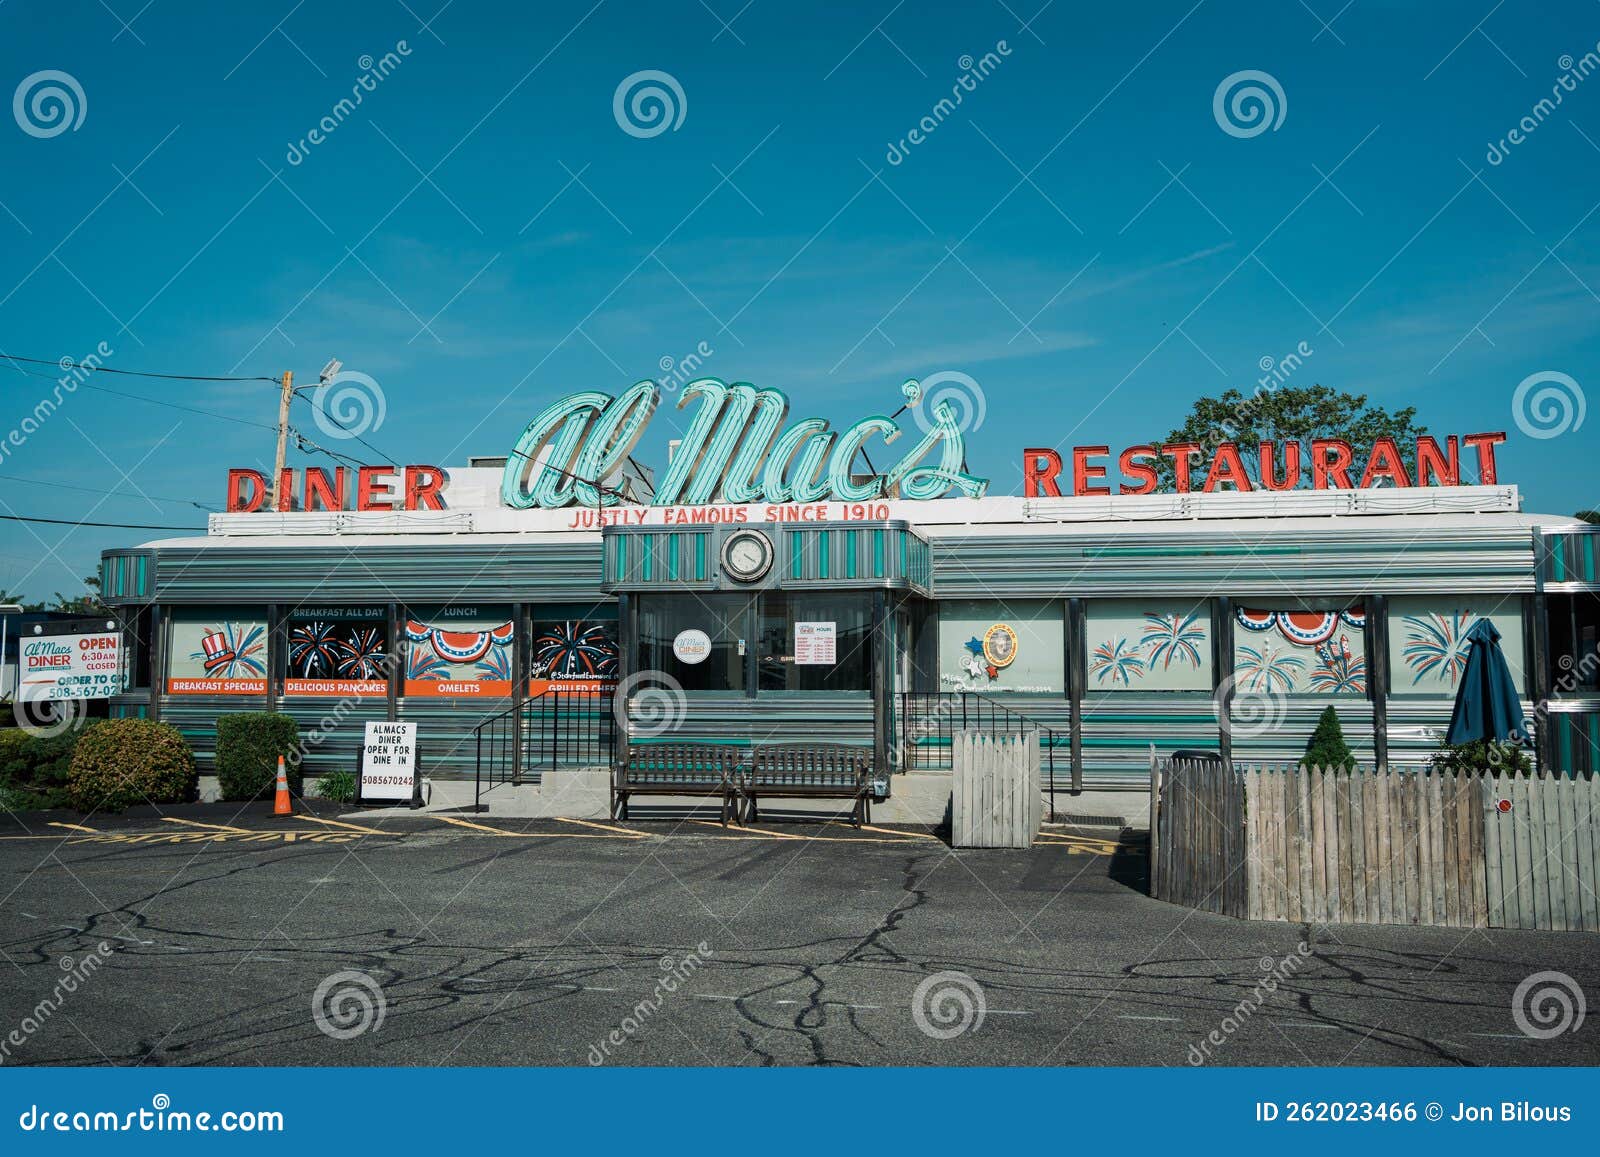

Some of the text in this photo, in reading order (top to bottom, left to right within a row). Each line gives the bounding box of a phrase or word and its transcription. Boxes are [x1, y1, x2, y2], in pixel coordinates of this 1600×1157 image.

[1022, 431, 1507, 498] RESTAURANT
[226, 464, 451, 513] DINER
[568, 503, 890, 529] JUSTLY FAMOUS SINCE 1910
[293, 608, 384, 617] BREAKFAST ALL DAY
[444, 608, 477, 616] LUNCH
[79, 637, 116, 650] OPEN
[29, 655, 71, 666] DINER
[86, 662, 116, 670] CLOSED
[57, 675, 91, 685] ORDER
[94, 675, 108, 684] TO
[173, 682, 265, 691] BREAKFAST SPECIALS
[287, 682, 386, 692] DELICIOUS PANCAKES
[438, 684, 480, 693] OMELETS
[49, 685, 118, 698] 508-567-02
[373, 725, 407, 734] ALMACS
[378, 735, 402, 744] DINER
[367, 745, 410, 754] OPEN FOR
[373, 755, 407, 764] DINE IN
[362, 775, 414, 785] 5085670242
